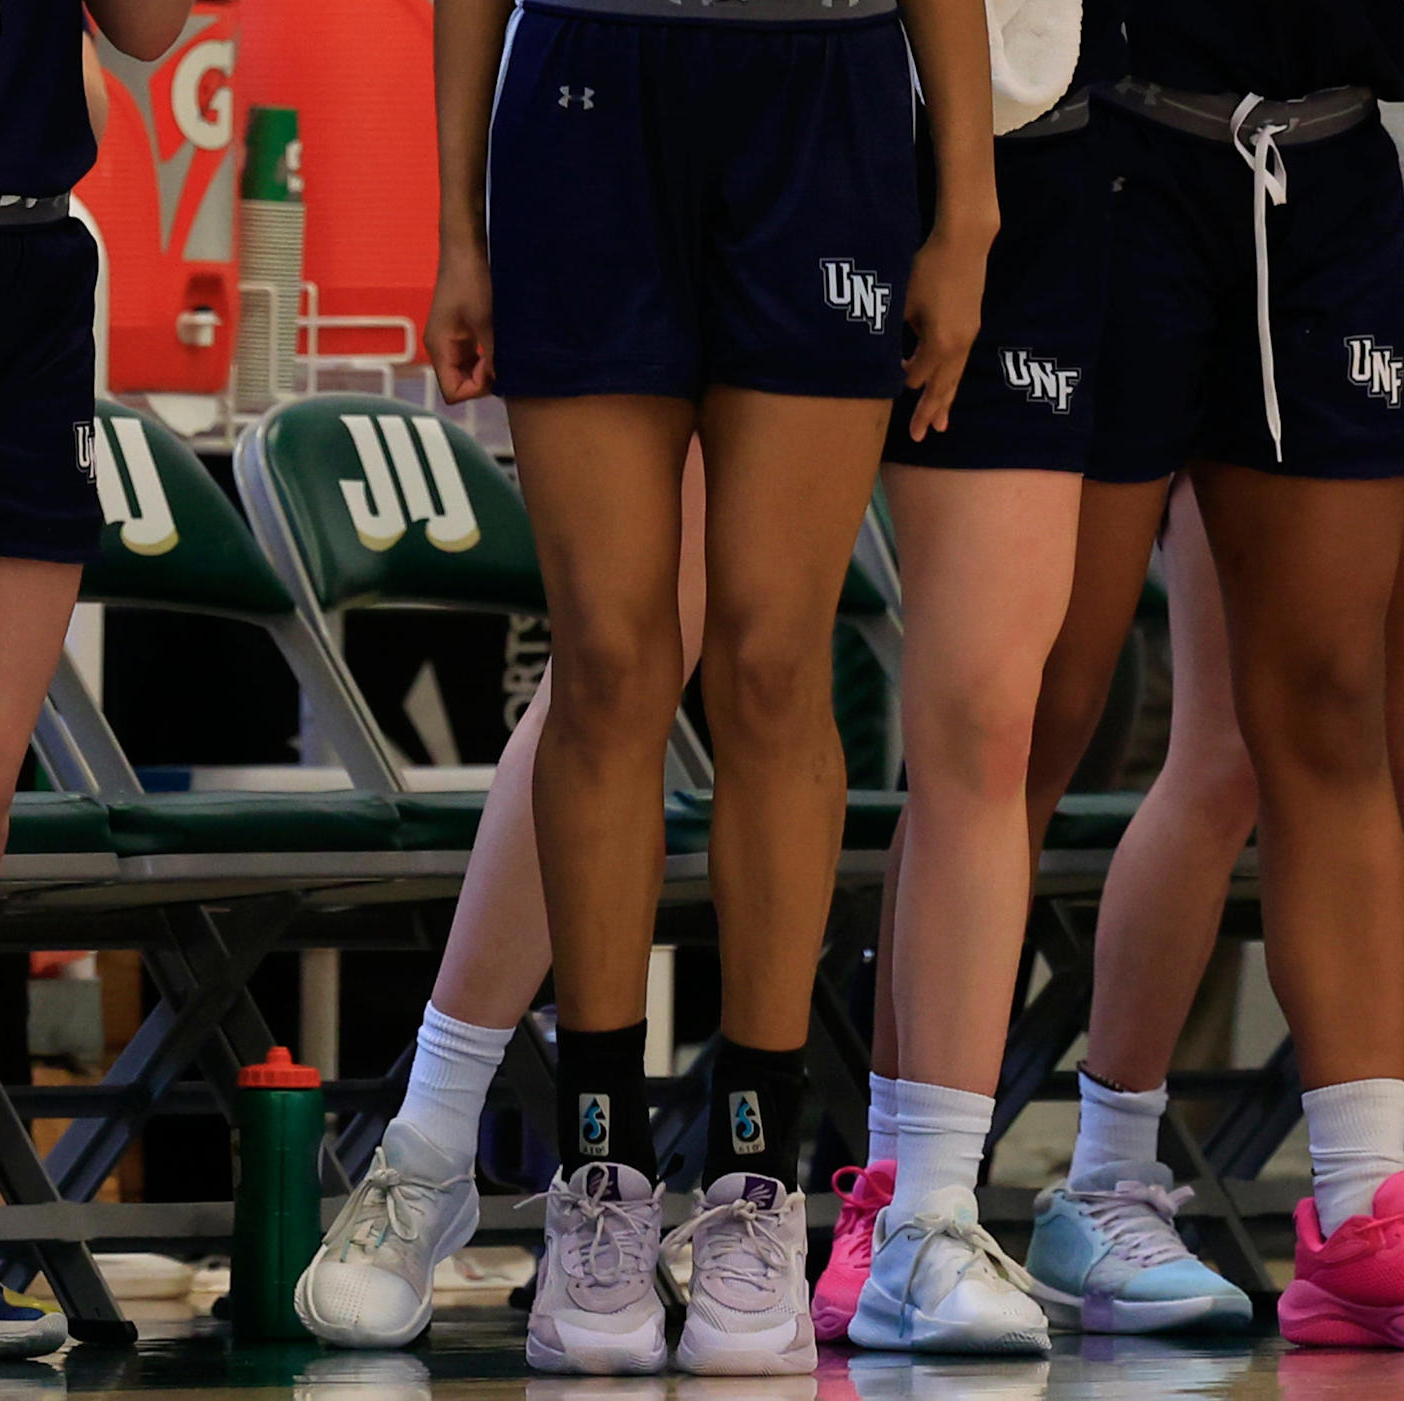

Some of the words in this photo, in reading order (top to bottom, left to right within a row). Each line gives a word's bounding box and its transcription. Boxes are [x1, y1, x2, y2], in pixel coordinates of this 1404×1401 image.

[171, 39, 235, 150] G
[822, 260, 891, 332] UNF
[1001, 349, 1080, 412] UNF
[1346, 337, 1404, 406] UNF
[339, 415, 481, 553] JU
